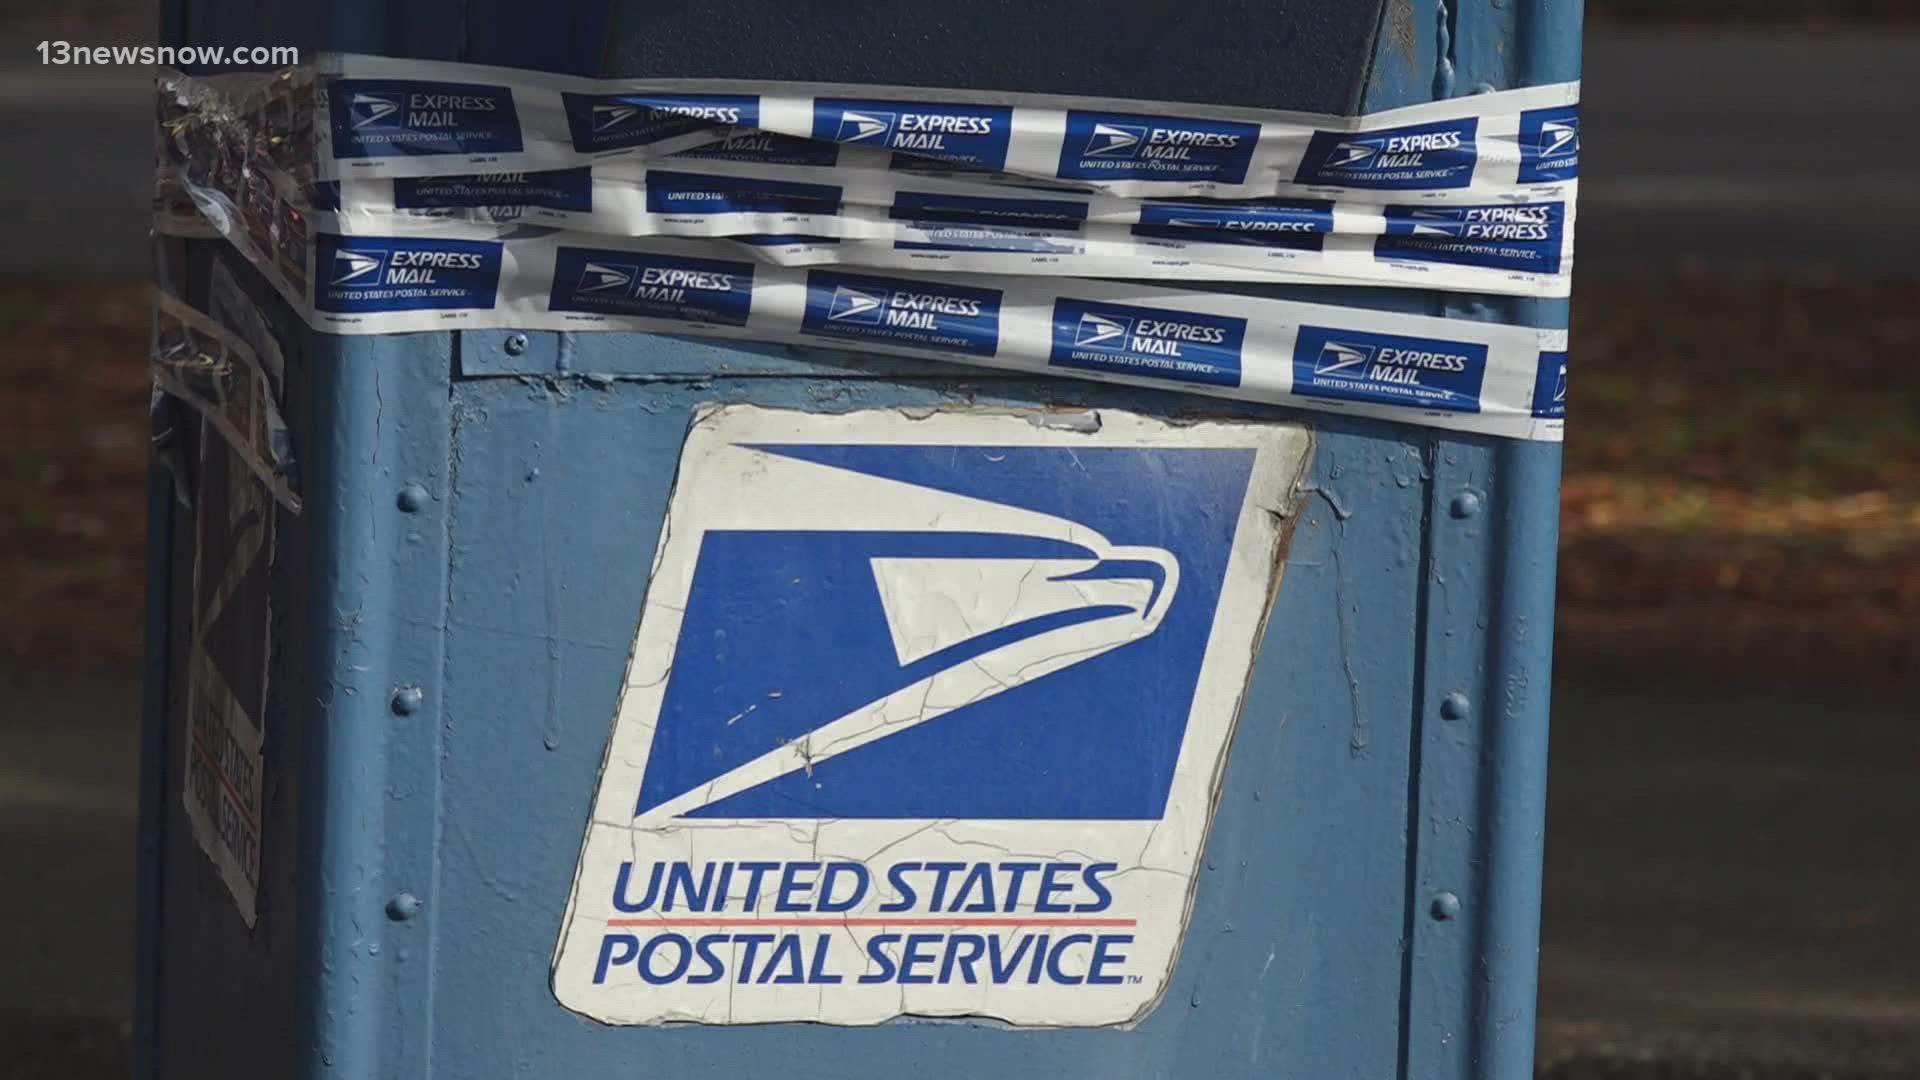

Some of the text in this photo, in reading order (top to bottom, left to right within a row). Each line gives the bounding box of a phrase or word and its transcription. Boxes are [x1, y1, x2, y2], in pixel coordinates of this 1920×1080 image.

[409, 93, 497, 112] EXPRESS
[407, 112, 459, 128] MAIL
[899, 113, 993, 135] EXPRESS
[892, 133, 946, 150] MAIL
[1149, 128, 1241, 149] EXPRESS
[1386, 131, 1462, 153] EXPRESS
[1140, 145, 1192, 160] MAIL
[1376, 152, 1424, 169] MAIL
[1079, 159, 1114, 169] UNITED
[1114, 160, 1147, 170] STATES
[1147, 160, 1181, 171] POSTAL
[1382, 171, 1414, 180] POSTAL
[1414, 168, 1448, 178] SERVICE
[667, 192, 705, 201] UNITED
[1464, 206, 1551, 224] EXPRESS
[1466, 223, 1550, 240] EXPRESS
[391, 251, 483, 270] EXPRESS
[1464, 245, 1499, 256] POSTAL
[1499, 247, 1537, 260] SERVICE
[385, 268, 437, 285] MAIL
[640, 267, 734, 291] EXPRESS
[363, 289, 393, 300] STATES
[394, 288, 428, 298] POSTAL
[428, 287, 467, 297] SERVICE
[634, 287, 688, 304] MAIL
[890, 291, 982, 316] EXPRESS
[885, 309, 939, 331] MAIL
[823, 323, 860, 333] UNITED
[894, 331, 929, 342] POSTAL
[929, 335, 969, 347] SERVICE
[1135, 319, 1227, 344] EXPRESS
[1131, 336, 1183, 358] MAIL
[1071, 350, 1215, 374] UNITED STATES POSTAL SERVICE
[1376, 347, 1468, 373] EXPRESS
[1369, 365, 1421, 385] MAIL
[1312, 376, 1453, 400] UNITED STATES POSTAL SERVICE
[611, 861, 1117, 914] UNITED STATES
[591, 933, 843, 985] POSTAL
[858, 933, 1135, 985] SERVICE
